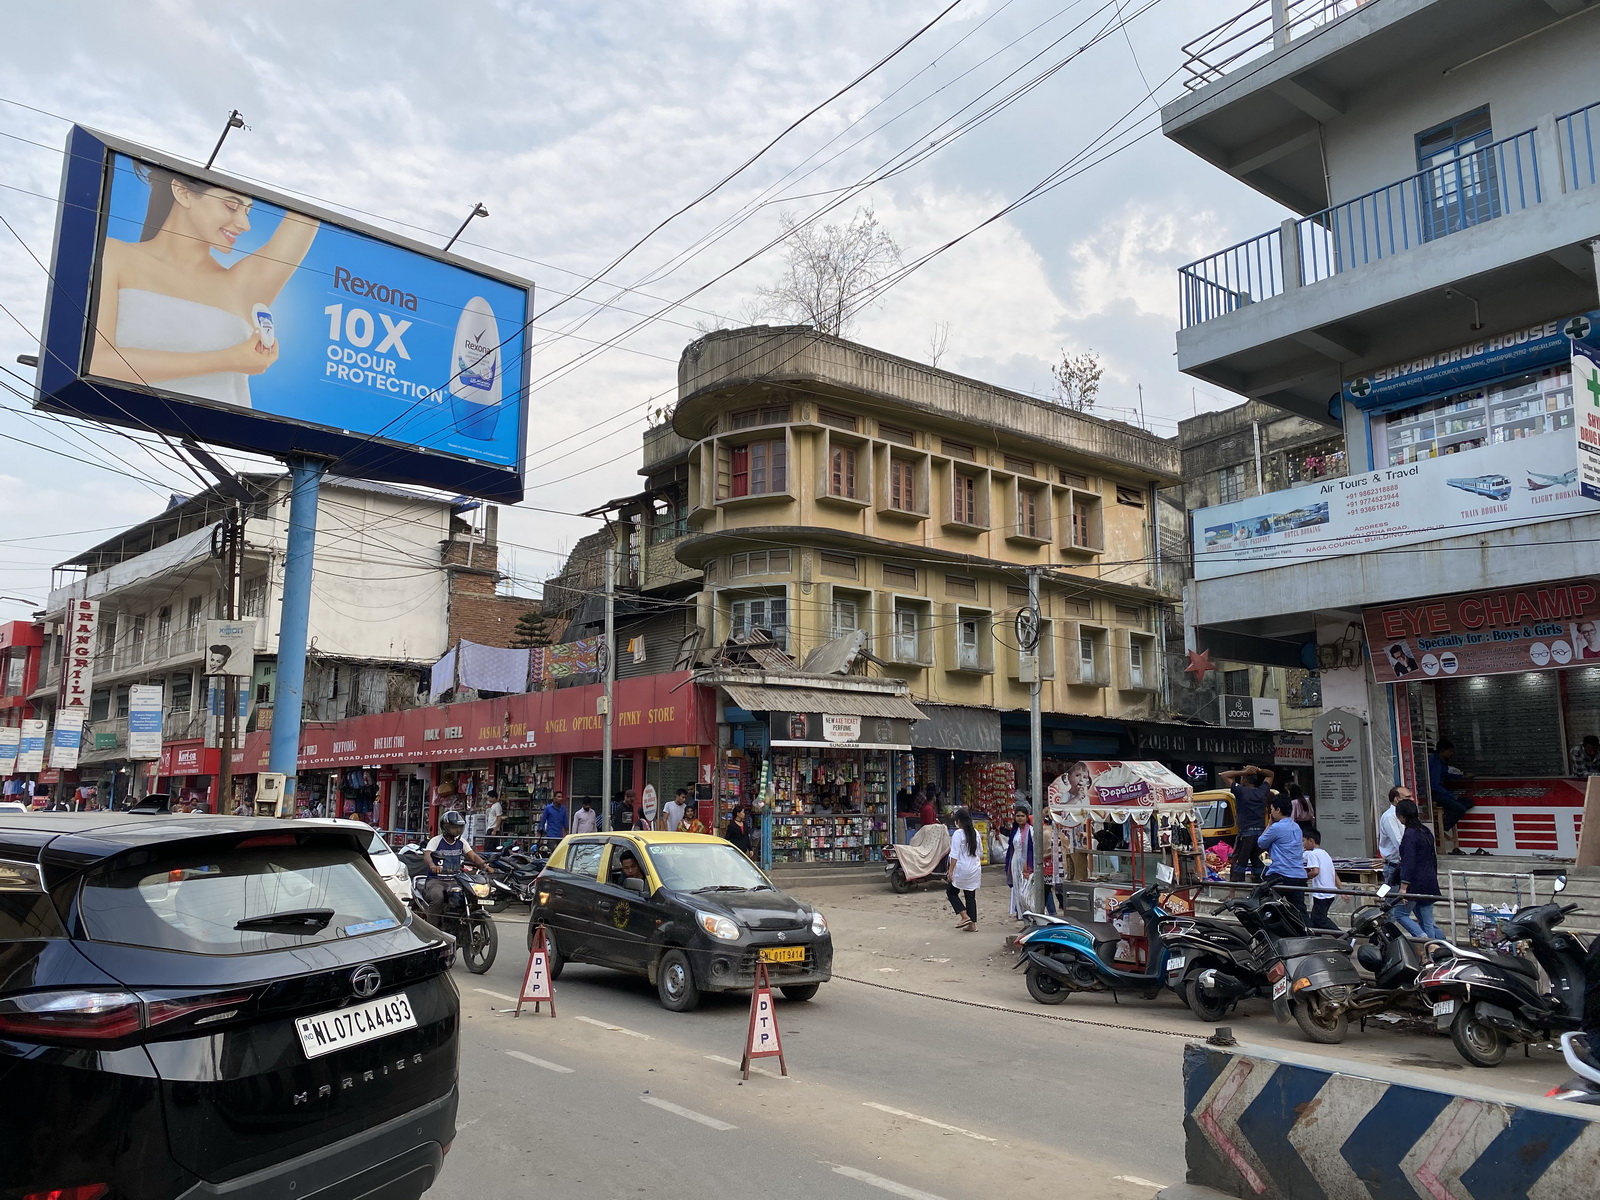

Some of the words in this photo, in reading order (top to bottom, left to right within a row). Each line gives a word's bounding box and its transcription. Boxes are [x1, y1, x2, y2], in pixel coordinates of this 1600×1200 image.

[333, 266, 418, 312] Rexona
[324, 303, 413, 360] 10X
[465, 339, 491, 354] Rexona
[1374, 355, 1436, 383] SHYAM
[1438, 343, 1484, 366] DRUG
[1489, 320, 1558, 353] HOUSE
[326, 345, 397, 376] ODOUR
[325, 361, 445, 404] PROTECTION
[1587, 412, 1600, 430] SHY
[1580, 426, 1597, 445] DRUG
[1320, 484, 1335, 495] Air
[1339, 477, 1368, 491] Tours
[1372, 473, 1382, 483] &
[1386, 465, 1419, 480] Travel
[1531, 493, 1553, 505] FLIGHT
[1555, 488, 1581, 500] BOOKIN
[1461, 508, 1479, 519] TRAIN
[1481, 503, 1508, 516] BOOKING
[1354, 521, 1389, 532] ADDRESS
[1306, 544, 1328, 553] NAGA
[1331, 537, 1363, 549] COUNCIL
[1364, 532, 1404, 543] BUILDING
[1382, 604, 1450, 639] EYE
[1458, 585, 1597, 630] CHAMP
[1418, 634, 1464, 651] Specially
[1466, 633, 1483, 644] for
[1493, 629, 1520, 642] Boys
[1523, 626, 1534, 638] &
[1534, 624, 1563, 636] Girls
[544, 719, 568, 734] ANGEL
[572, 715, 603, 731] OPTICAL
[618, 710, 642, 727] PINKY
[648, 706, 675, 724] STORE
[835, 717, 844, 725] AXE
[844, 717, 858, 725] TICKET
[1228, 710, 1251, 718] JOCKEY
[444, 726, 464, 740] WELL
[478, 726, 501, 740] JASIKA
[310, 756, 335, 765] LOTHA
[364, 752, 404, 760] DIMAPUR
[430, 748, 464, 756] 797112
[469, 742, 537, 753] NAGALAND
[1291, 748, 1312, 759] CENTRE
[532, 957, 543, 992] DTP
[312, 1000, 412, 1046] NL07CA4493
[759, 1000, 770, 1045] DTP
[304, 1033, 314, 1042] IND
[293, 1053, 423, 1106] HARRIER
